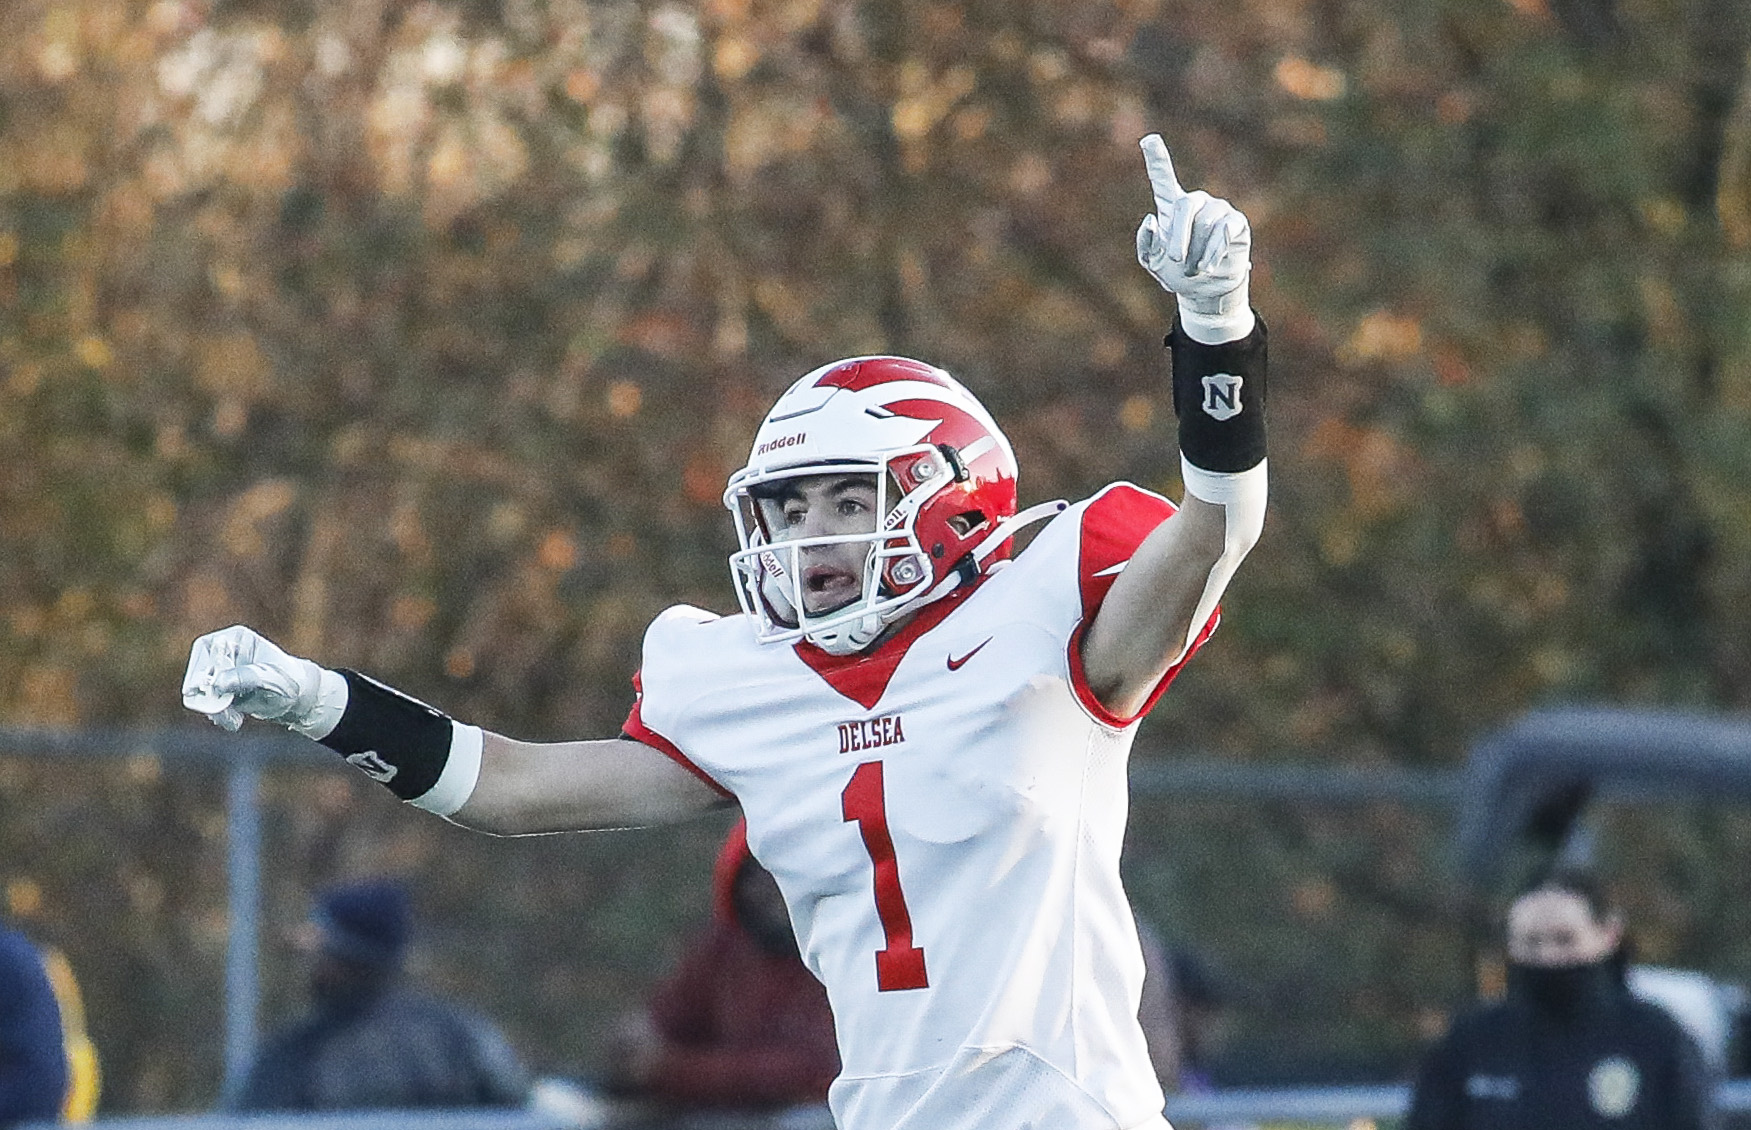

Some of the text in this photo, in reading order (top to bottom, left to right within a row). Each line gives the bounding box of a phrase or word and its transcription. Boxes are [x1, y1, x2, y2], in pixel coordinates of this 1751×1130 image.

[1208, 382, 1238, 410] N
[758, 432, 806, 456] Riddell
[838, 716, 905, 753] DELSEA
[841, 760, 929, 993] 1
